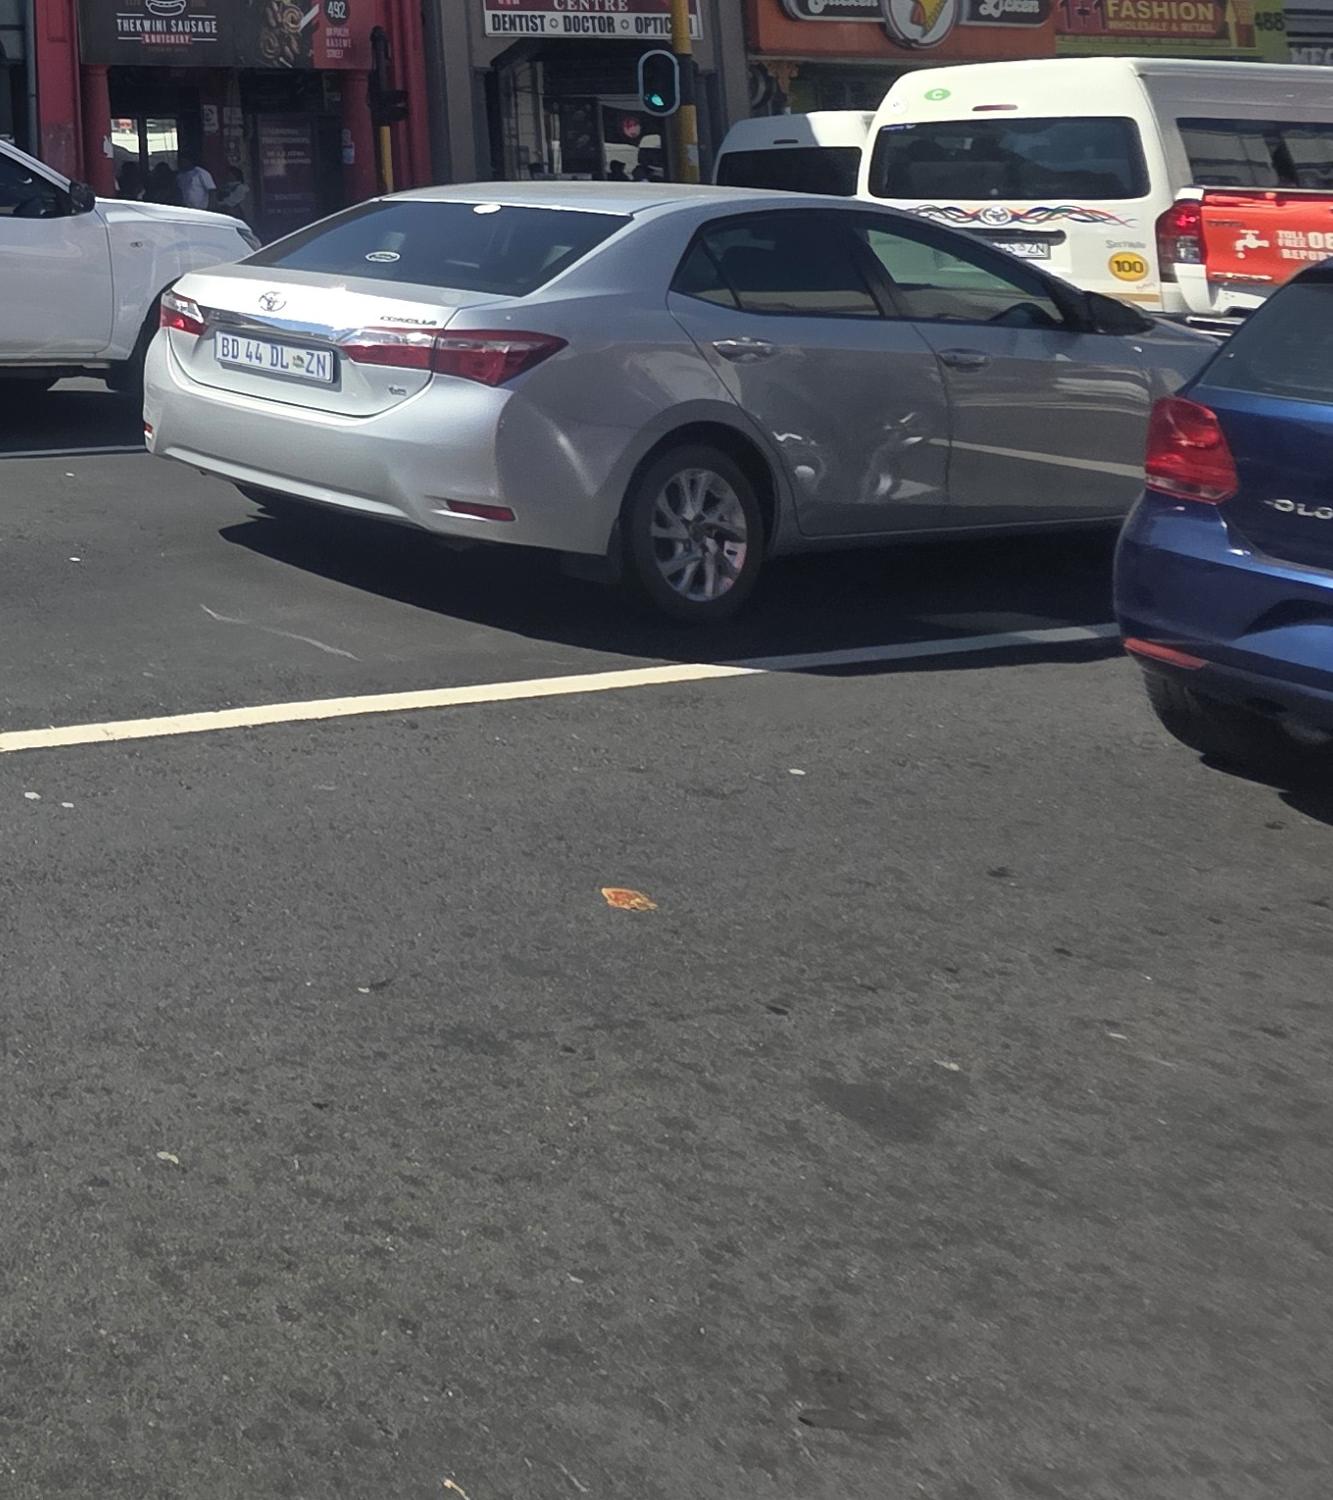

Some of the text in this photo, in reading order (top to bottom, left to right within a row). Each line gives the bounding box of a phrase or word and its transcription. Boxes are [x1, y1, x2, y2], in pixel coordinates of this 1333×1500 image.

[327, 1, 347, 19] 492
[1107, 0, 1215, 21] FASHION
[116, 18, 218, 33] THEKWINI SAUSAGE
[492, 14, 546, 32] DENTIST
[563, 15, 616, 34] DOCTOR
[1108, 20, 1169, 32] WHOLESALE
[1277, 230, 1304, 239] TOLL
[1114, 260, 1144, 274] 100
[221, 338, 327, 375] BD 44 DL ZN
